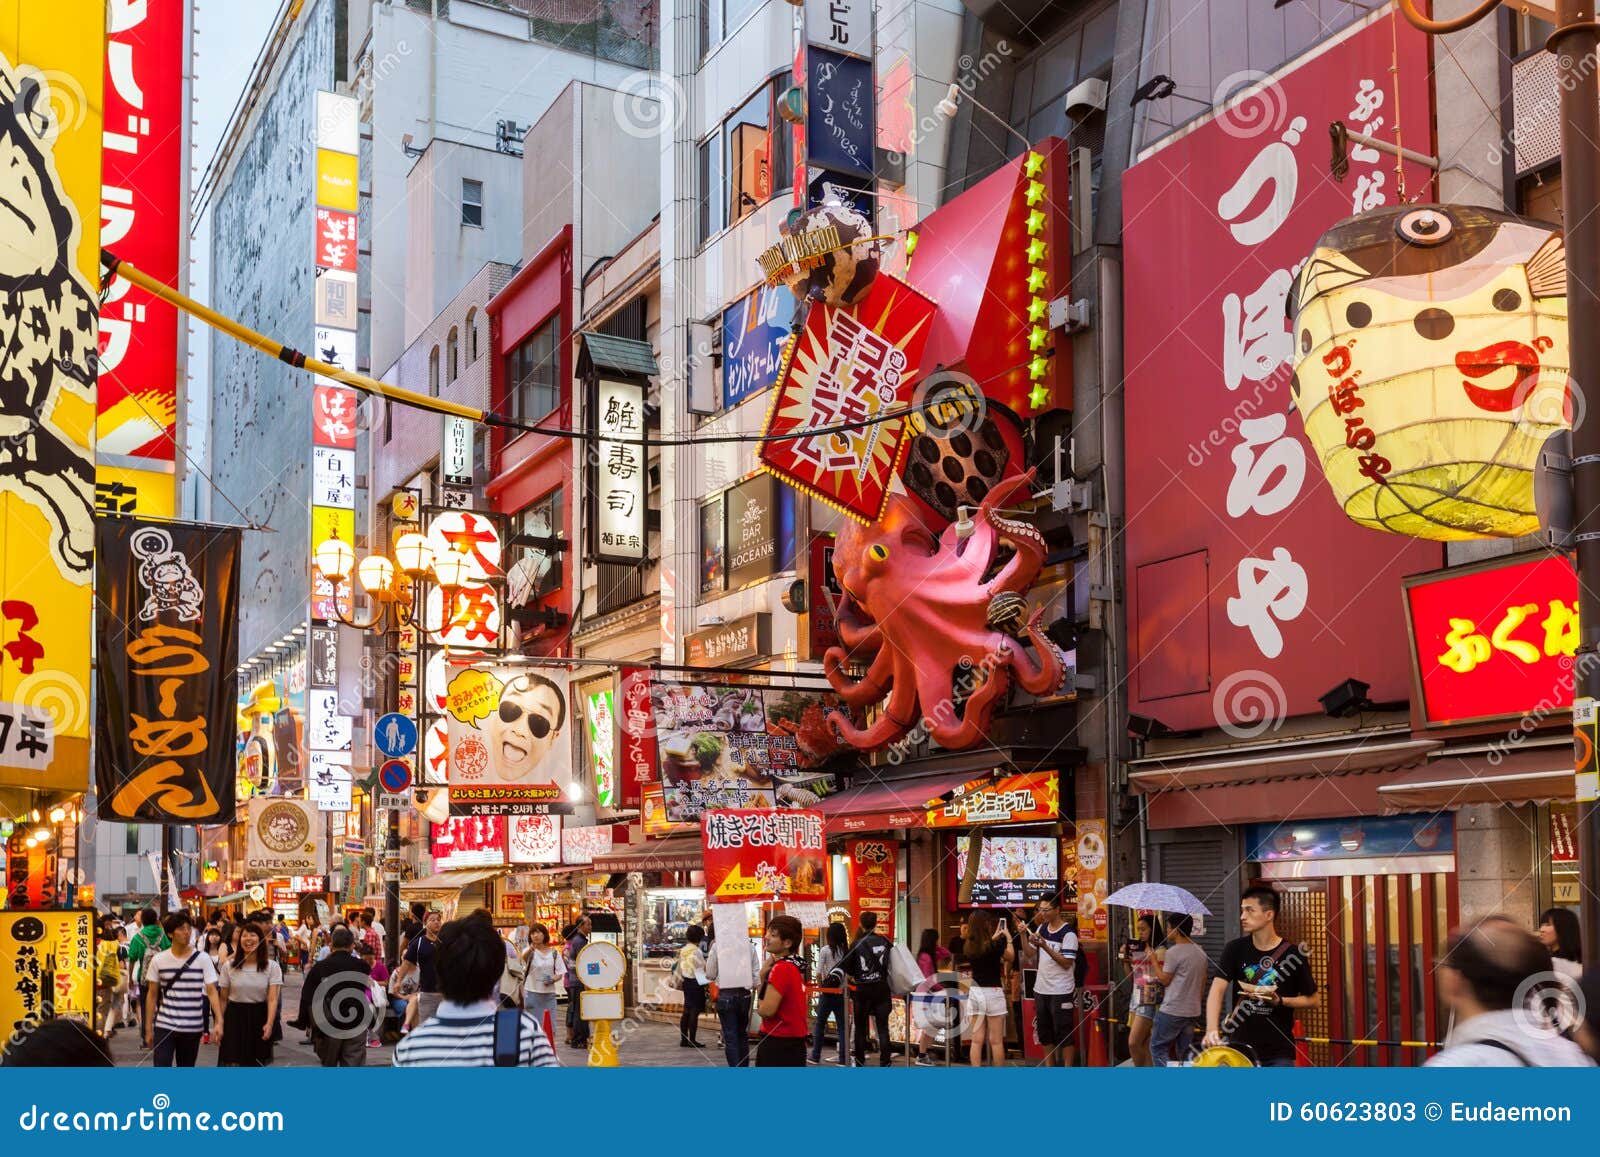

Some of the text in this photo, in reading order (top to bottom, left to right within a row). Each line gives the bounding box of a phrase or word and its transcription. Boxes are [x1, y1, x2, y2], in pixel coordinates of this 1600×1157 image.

[601, 533, 640, 548] 菊正宗
[742, 524, 761, 542] BAR
[111, 624, 221, 818] らーめん
[707, 813, 824, 849] 焼きそば専門店
[249, 859, 281, 868] CAFE
